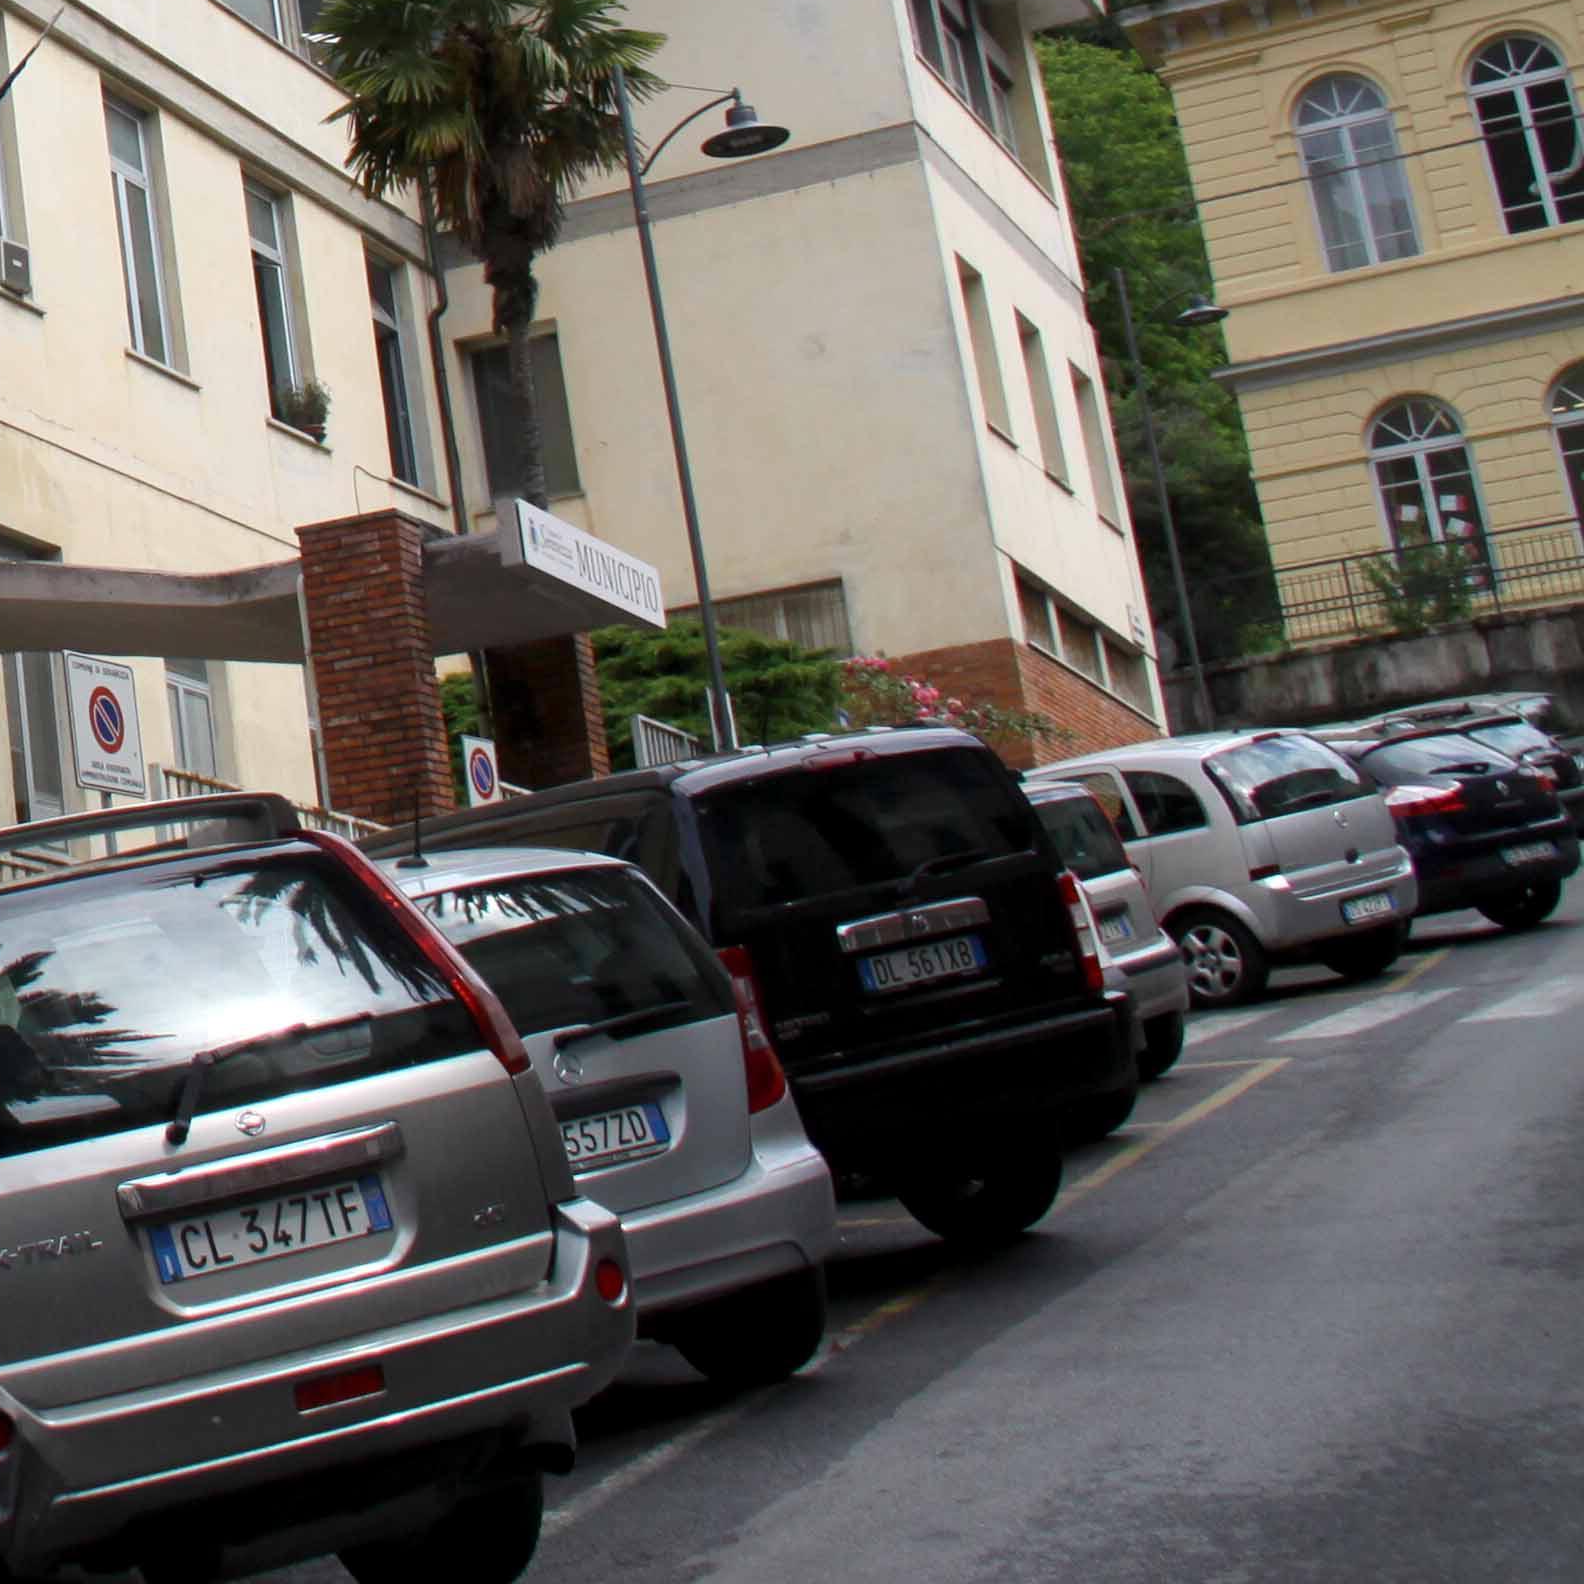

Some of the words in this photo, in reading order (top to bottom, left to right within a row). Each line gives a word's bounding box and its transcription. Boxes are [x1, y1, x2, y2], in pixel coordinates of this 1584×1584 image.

[575, 540, 659, 614] MUNICIPIO
[181, 1221, 234, 1269] CL
[239, 1185, 358, 1254] 347TF
